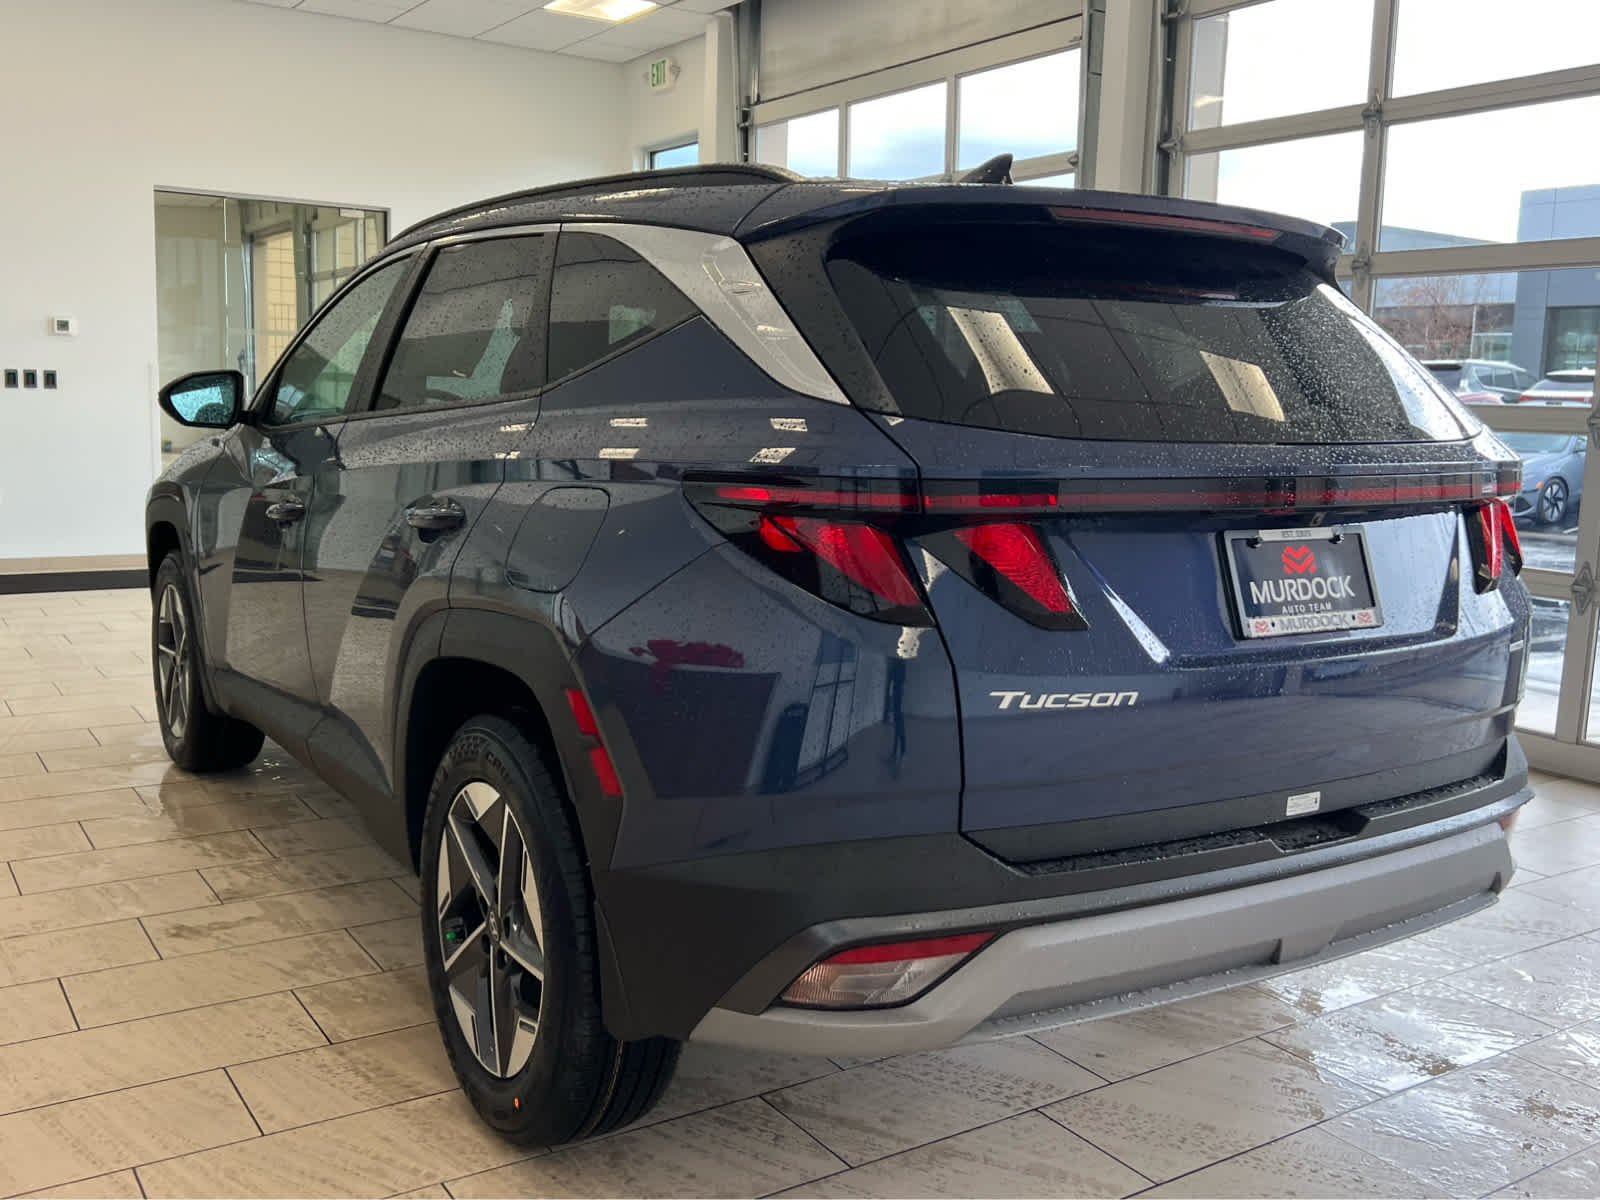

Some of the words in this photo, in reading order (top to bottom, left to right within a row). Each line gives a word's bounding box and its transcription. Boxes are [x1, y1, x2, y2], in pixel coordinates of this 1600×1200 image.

[651, 60, 666, 87] EXIT
[1250, 576, 1355, 604] MURDOCK
[1282, 604, 1305, 614] AUTO
[1309, 602, 1332, 612] TEAM
[1279, 613, 1349, 631] MURDOCK
